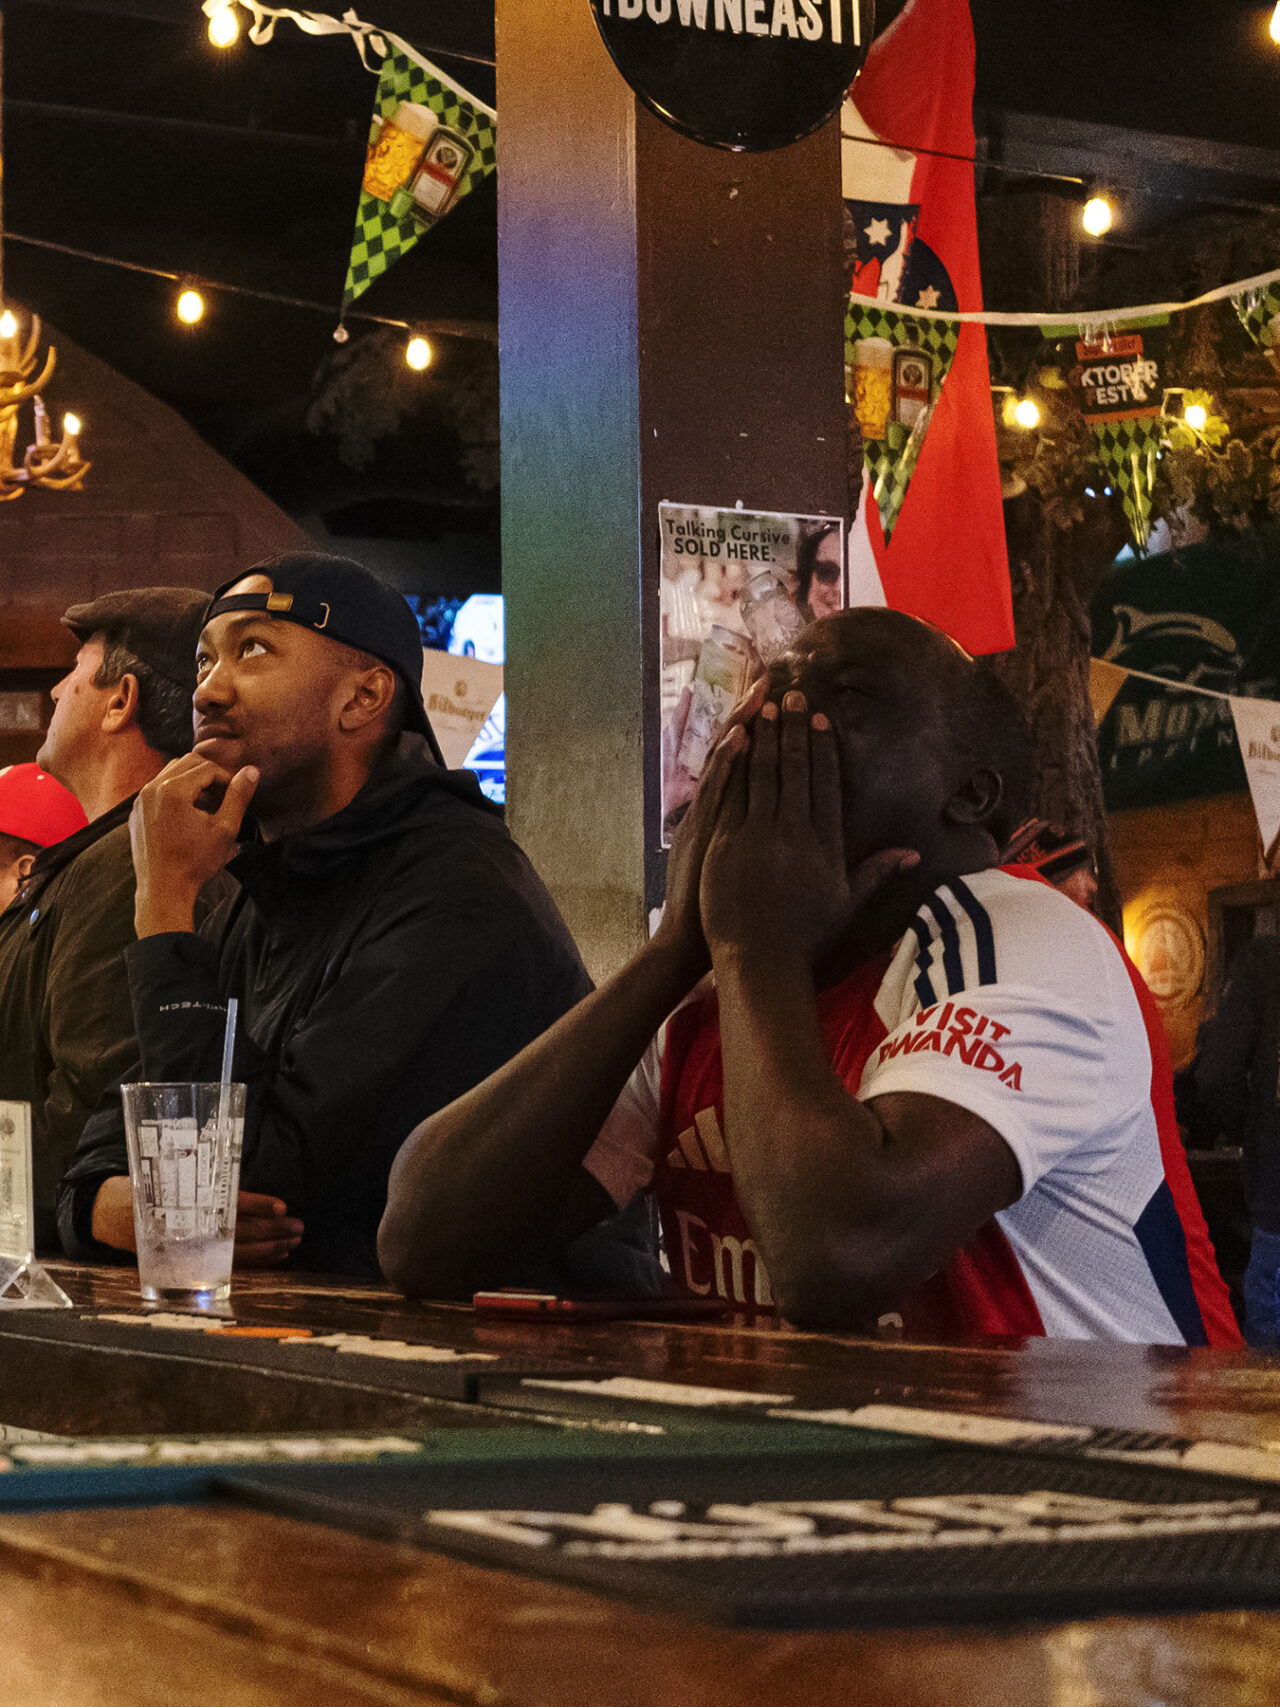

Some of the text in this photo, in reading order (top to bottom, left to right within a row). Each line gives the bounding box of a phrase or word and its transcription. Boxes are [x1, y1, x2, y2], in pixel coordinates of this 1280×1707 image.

[666, 520, 791, 545] Talking Cursive
[674, 538, 777, 562] SOLD HERE.
[916, 1002, 1012, 1041] VISIT
[879, 1030, 1023, 1092] RWANDA
